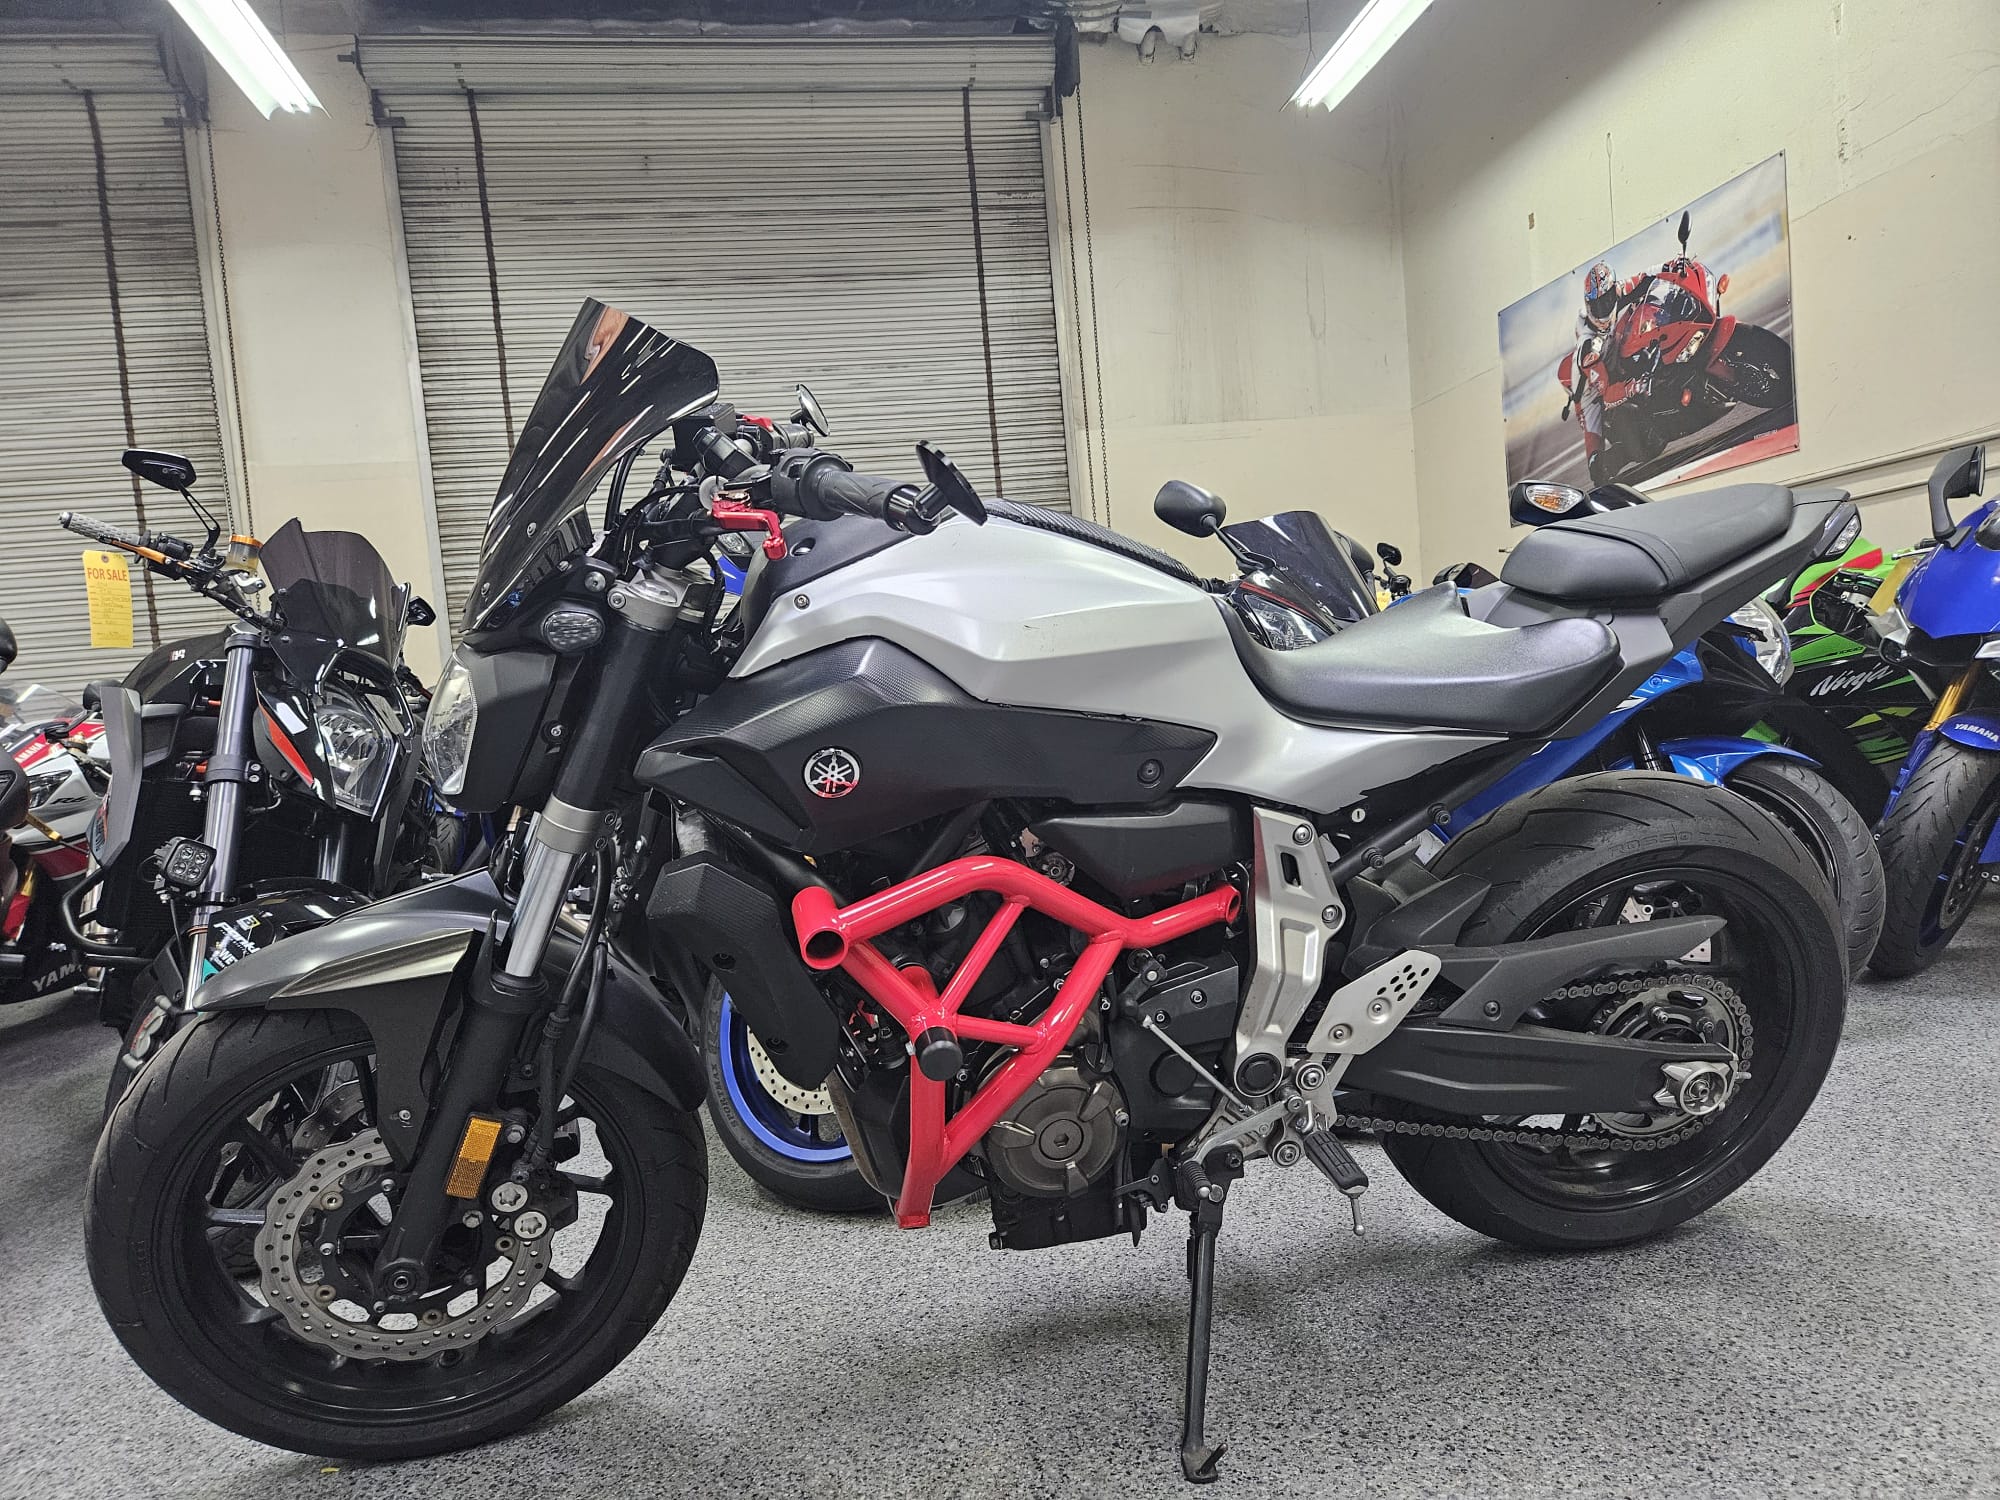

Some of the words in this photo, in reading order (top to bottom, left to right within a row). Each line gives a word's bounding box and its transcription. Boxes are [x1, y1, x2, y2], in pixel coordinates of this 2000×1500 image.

[87, 567, 105, 580] FOR
[107, 569, 128, 582] SALE
[1809, 662, 1894, 697] Ninja
[1954, 723, 1999, 743] YAMAHA
[14, 742, 46, 763] AMAHA
[31, 963, 82, 993] YAM
